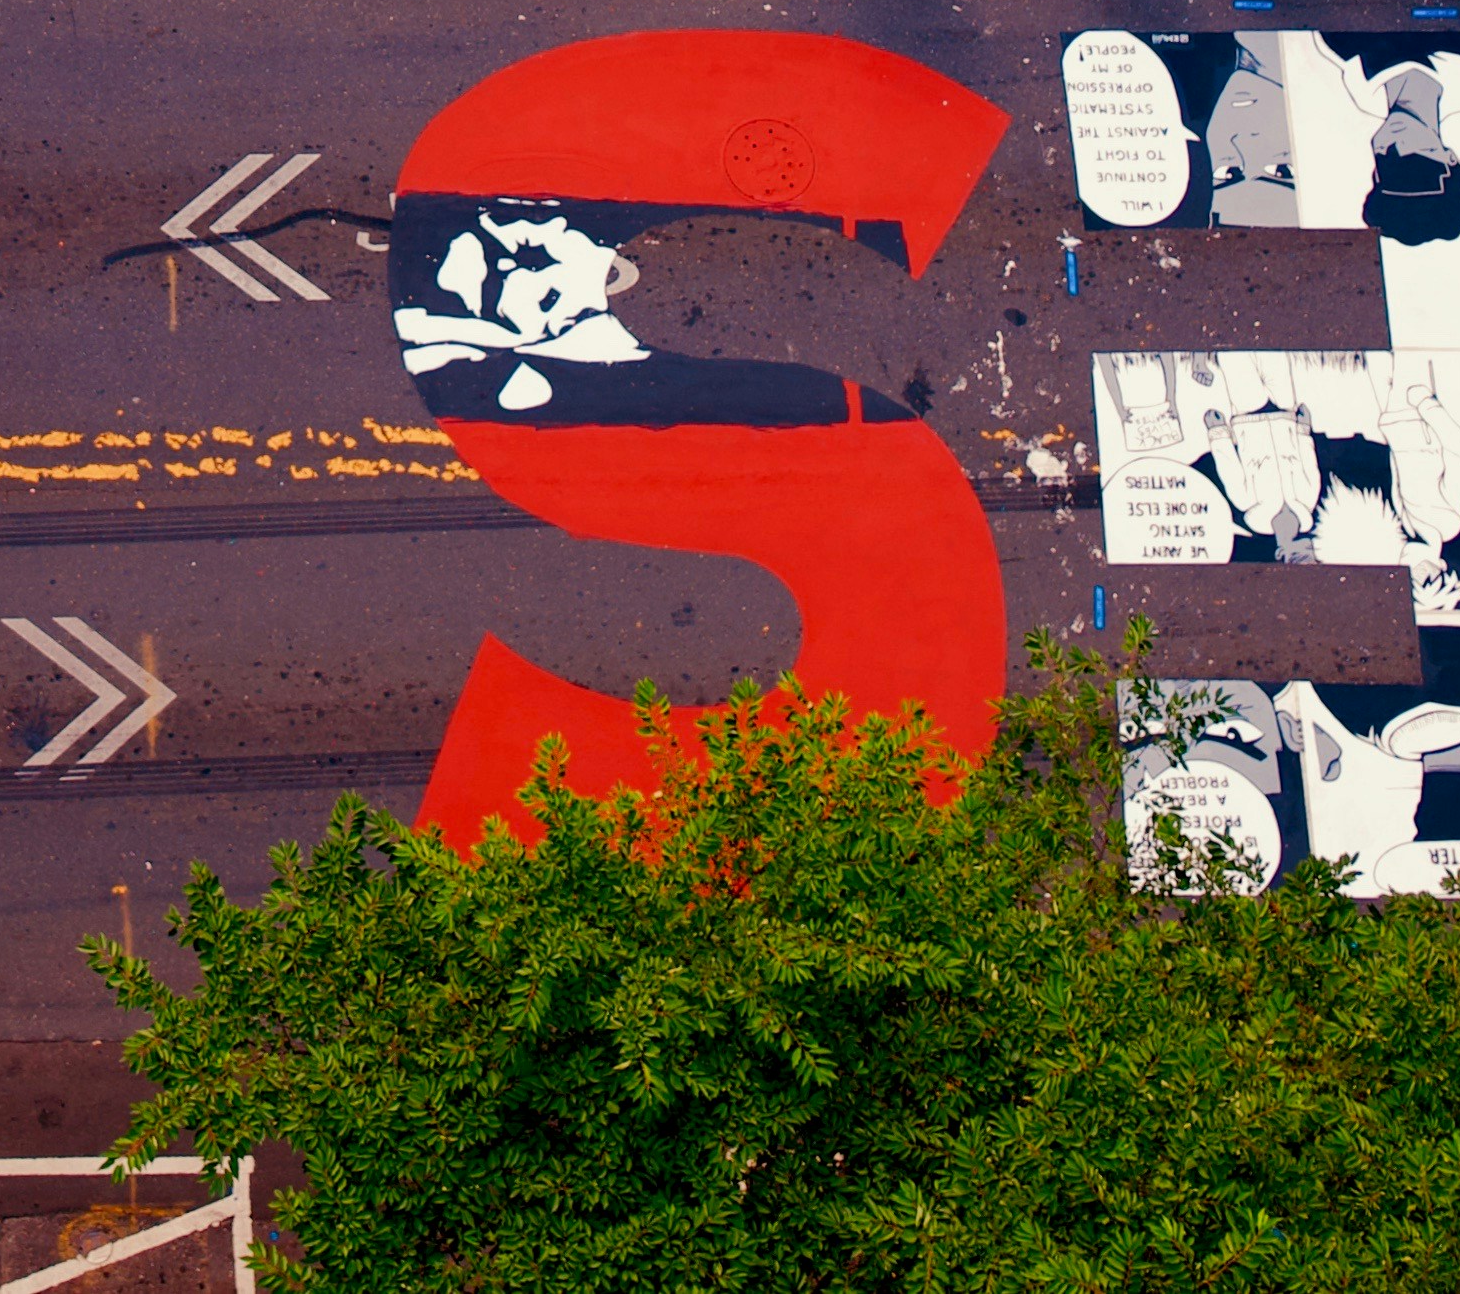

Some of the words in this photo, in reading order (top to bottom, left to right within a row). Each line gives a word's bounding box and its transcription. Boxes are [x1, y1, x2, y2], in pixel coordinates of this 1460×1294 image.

[1091, 63, 1109, 74] MY
[1115, 63, 1133, 73] OF
[1067, 81, 1154, 93] OPPRESSION
[1069, 102, 1154, 115] SYSTEMATIC
[1076, 126, 1099, 138] THE
[1106, 126, 1169, 138] AGAINST
[1096, 150, 1139, 161] FIGHT
[1146, 150, 1165, 161] TO
[1096, 171, 1167, 183] CONTINUE
[1120, 200, 1153, 211] WILL
[1125, 476, 1186, 490] MATTERS
[1127, 502, 1160, 517] ELSE
[1165, 502, 1187, 516] ONE
[1191, 502, 1208, 516] NO
[1149, 524, 1205, 537] SAYING
[1190, 546, 1209, 558] WE
[1159, 777, 1229, 790] PROBLEM
